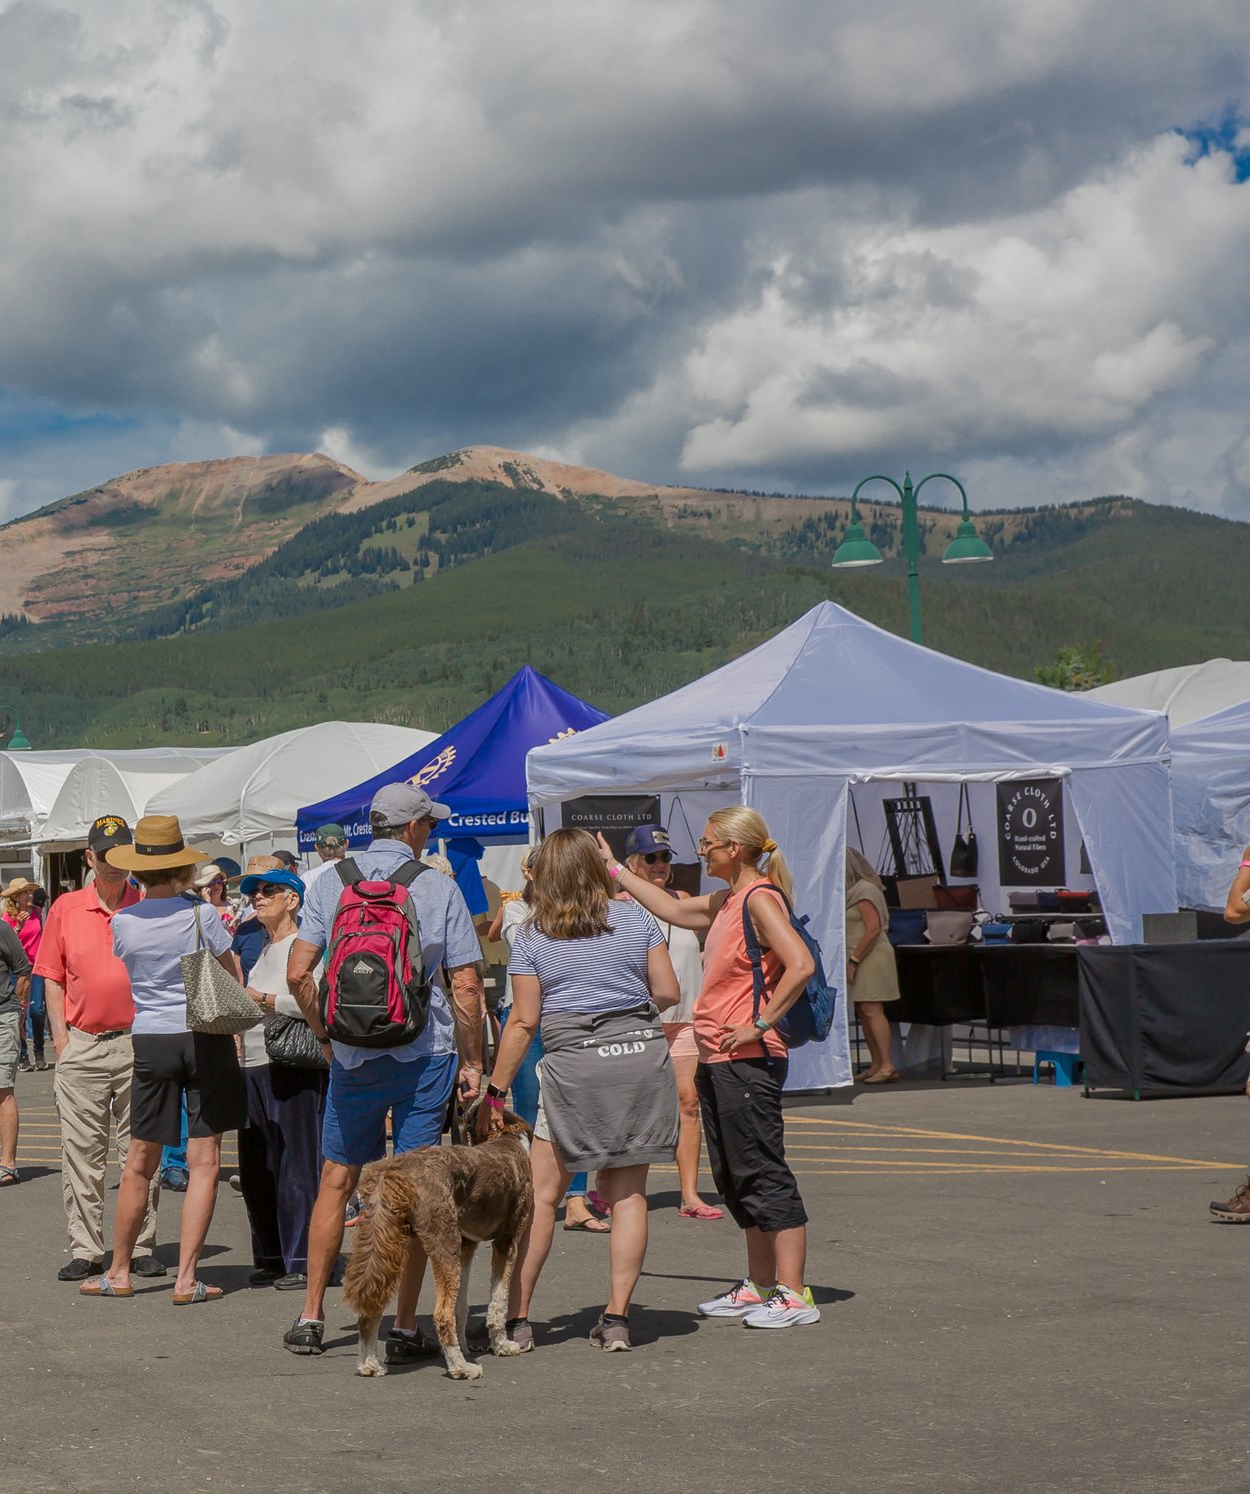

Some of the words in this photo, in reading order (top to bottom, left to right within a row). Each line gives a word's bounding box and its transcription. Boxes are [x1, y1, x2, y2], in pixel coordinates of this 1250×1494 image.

[448, 810, 507, 827] Crested
[571, 813, 604, 821] COARSE
[606, 813, 634, 821] CLOTH
[1024, 786, 1051, 809] CLOTH
[1048, 813, 1057, 839] LTD
[96, 817, 125, 829] MARINES
[1012, 856, 1039, 874] COLORADO
[597, 1041, 646, 1058] COLD
